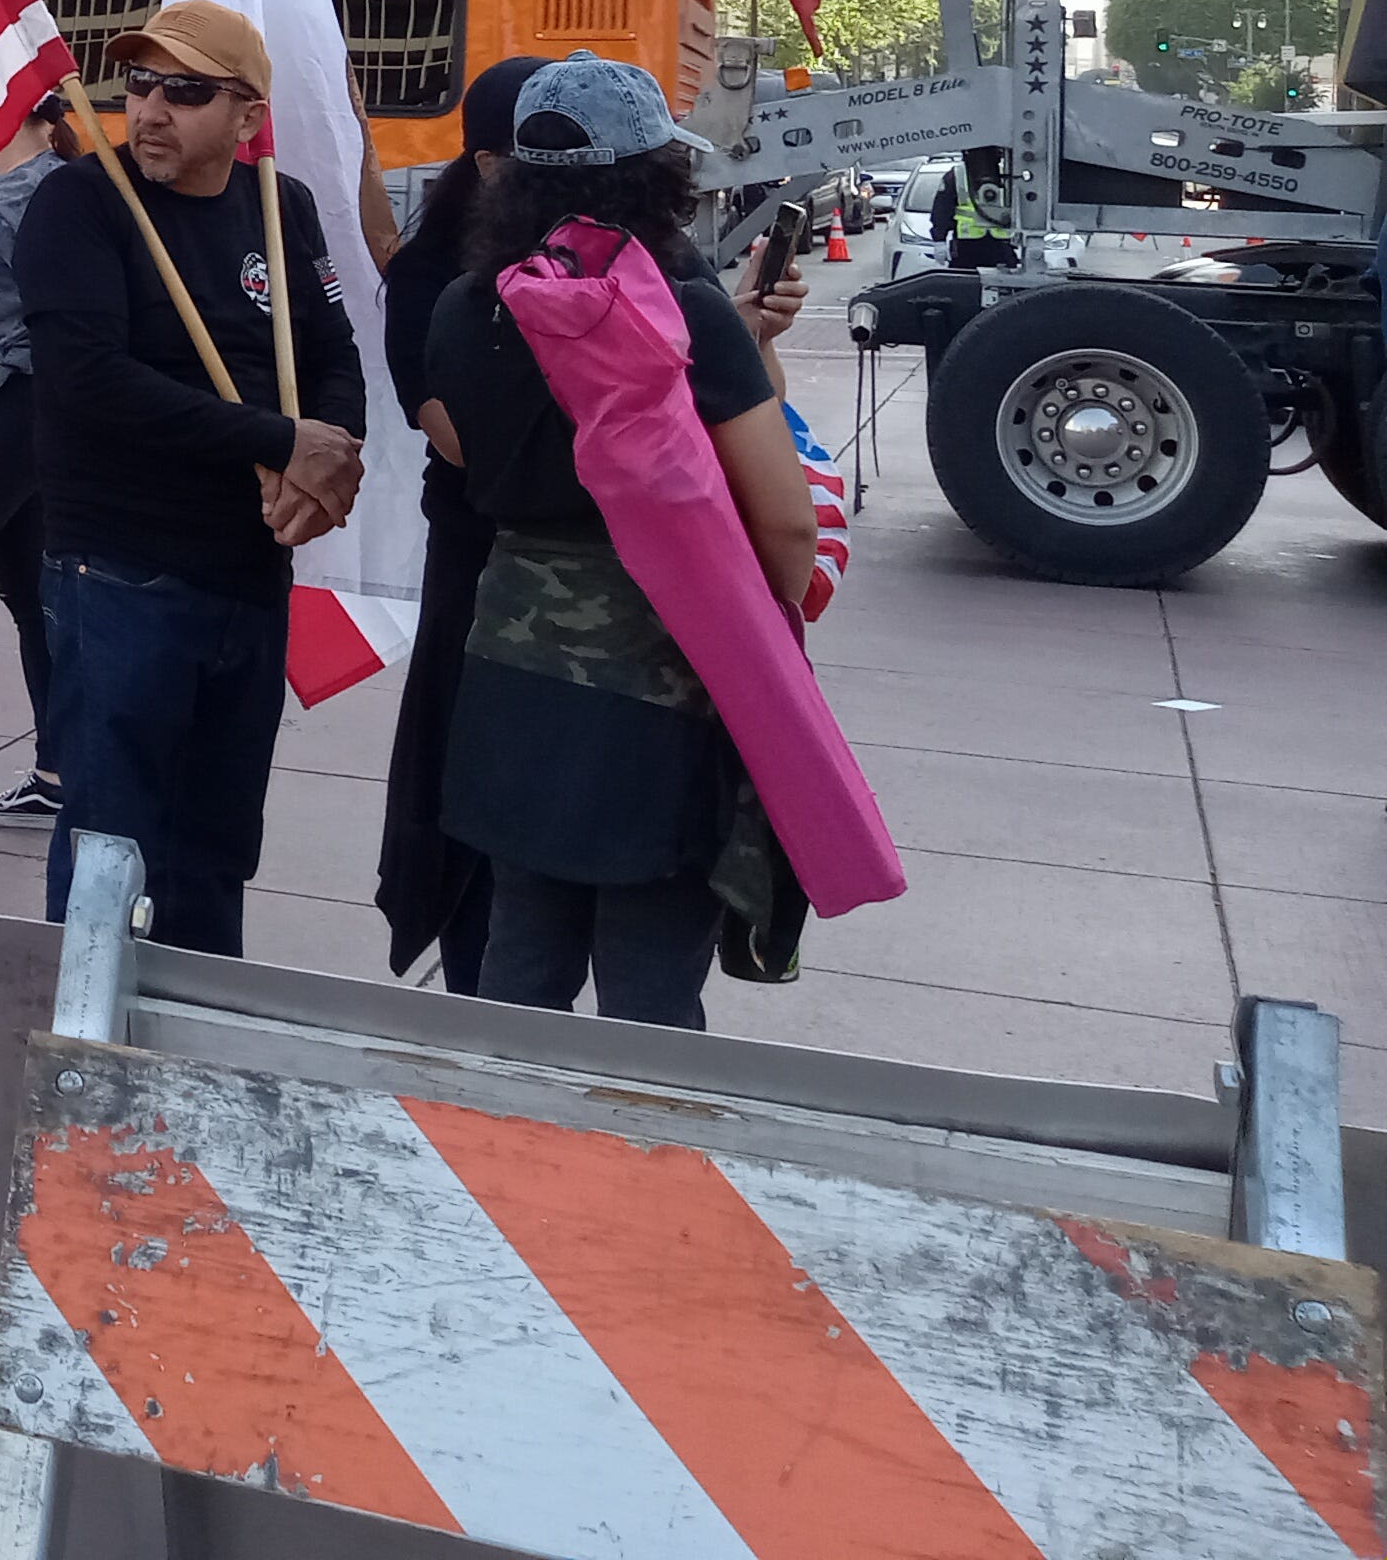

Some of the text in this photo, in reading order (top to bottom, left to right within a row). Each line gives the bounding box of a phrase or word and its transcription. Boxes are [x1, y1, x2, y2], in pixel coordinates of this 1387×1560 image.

[848, 77, 971, 108] MODEL 8 Elite
[1180, 105, 1284, 136] PRO-TOTE
[837, 122, 973, 155] www.protote.com
[1150, 151, 1299, 193] 800-259-4550
